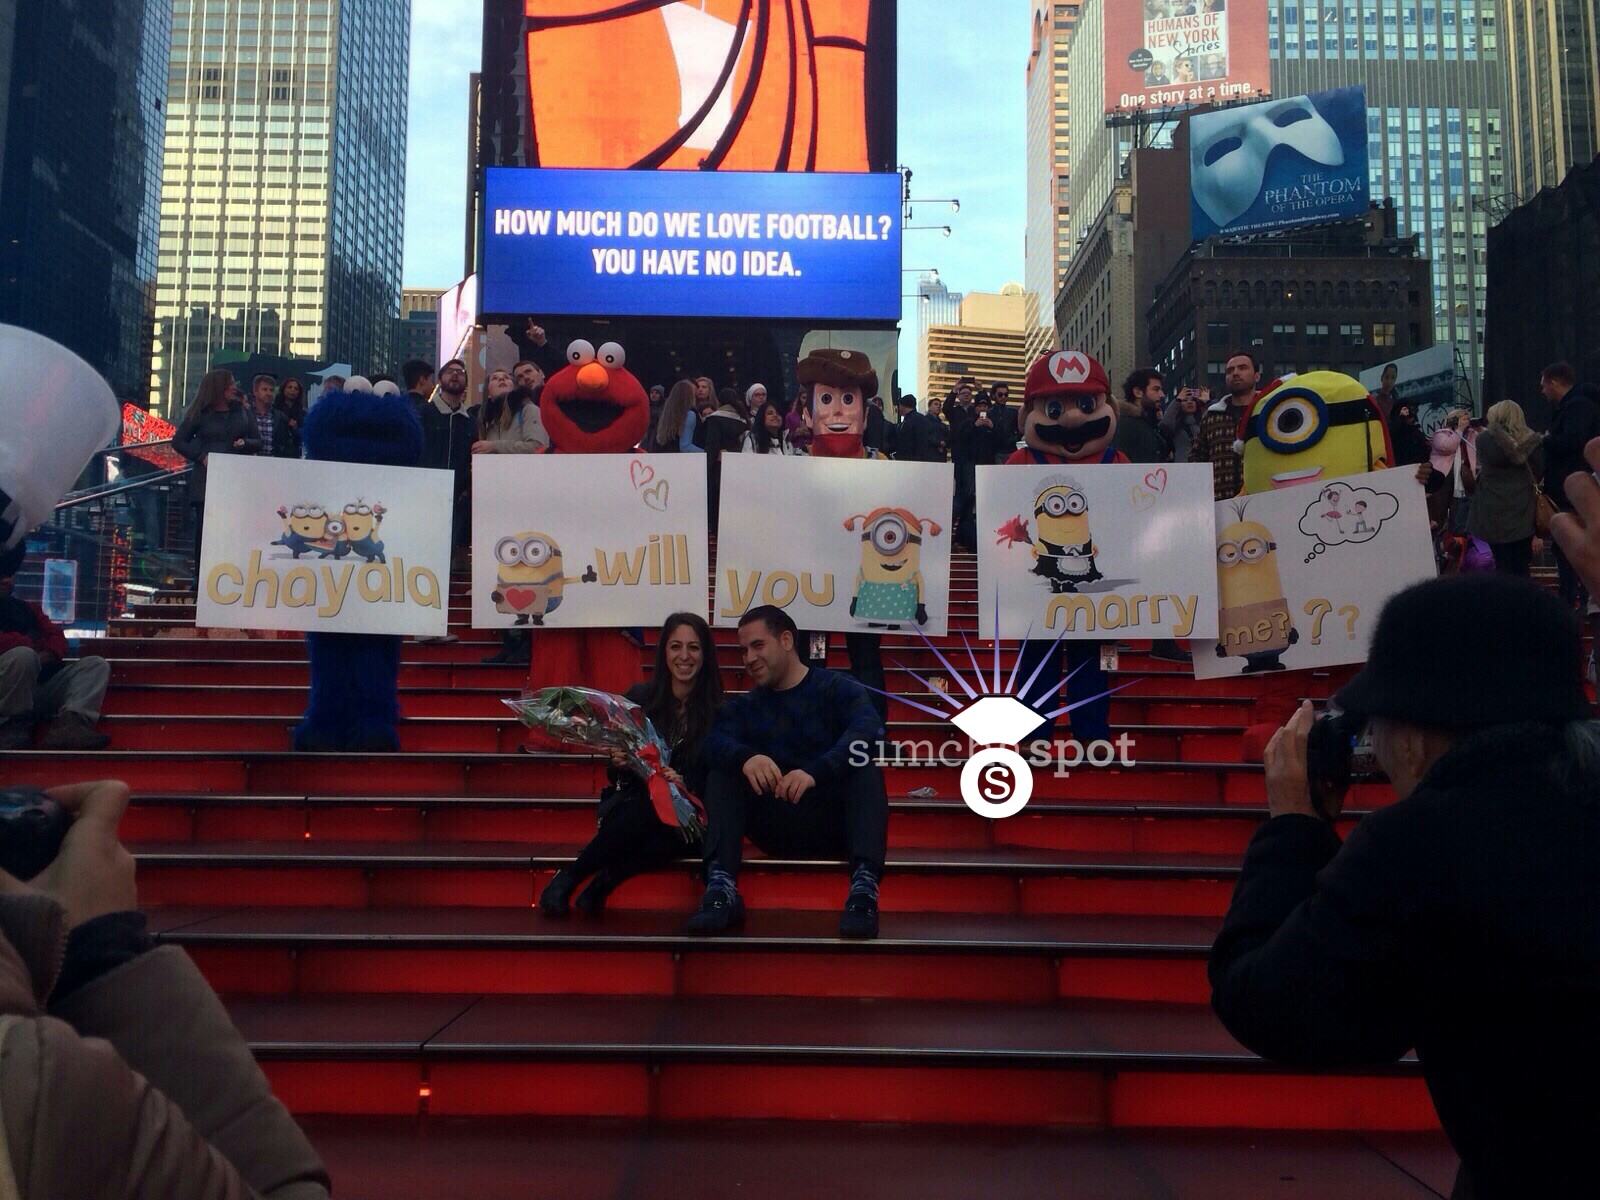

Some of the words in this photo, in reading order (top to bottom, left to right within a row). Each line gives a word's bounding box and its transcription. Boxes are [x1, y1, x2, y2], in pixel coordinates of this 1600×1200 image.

[1147, 14, 1200, 34] HUMANS
[1204, 12, 1220, 26] OF
[1148, 32, 1178, 49] NEW
[1183, 27, 1220, 45] YORK
[1173, 40, 1220, 60] Stories
[1120, 93, 1146, 108] One
[1150, 89, 1185, 106] story
[1189, 85, 1203, 100] at
[1207, 86, 1216, 98] a
[1219, 81, 1255, 97] time.
[1265, 176, 1361, 204] PHANTOM
[1301, 172, 1323, 184] THE
[1271, 203, 1286, 213] OF
[1290, 199, 1313, 210] THE
[1315, 194, 1354, 206] OPERA
[495, 209, 551, 235] HOW
[557, 210, 621, 237] MUCH
[628, 211, 658, 237] DO
[664, 212, 701, 238] WE
[706, 213, 760, 239] LOVE
[766, 213, 892, 241] FOOTBALL?
[592, 248, 635, 274] YOU
[642, 249, 700, 276] HAVE
[705, 250, 736, 276] NO
[743, 251, 802, 277] IDEA.
[1056, 356, 1085, 378] M
[593, 534, 691, 586] will
[206, 549, 442, 618] chayala
[721, 569, 835, 618] you
[1044, 593, 1198, 637] marry
[1220, 611, 1291, 647] me?
